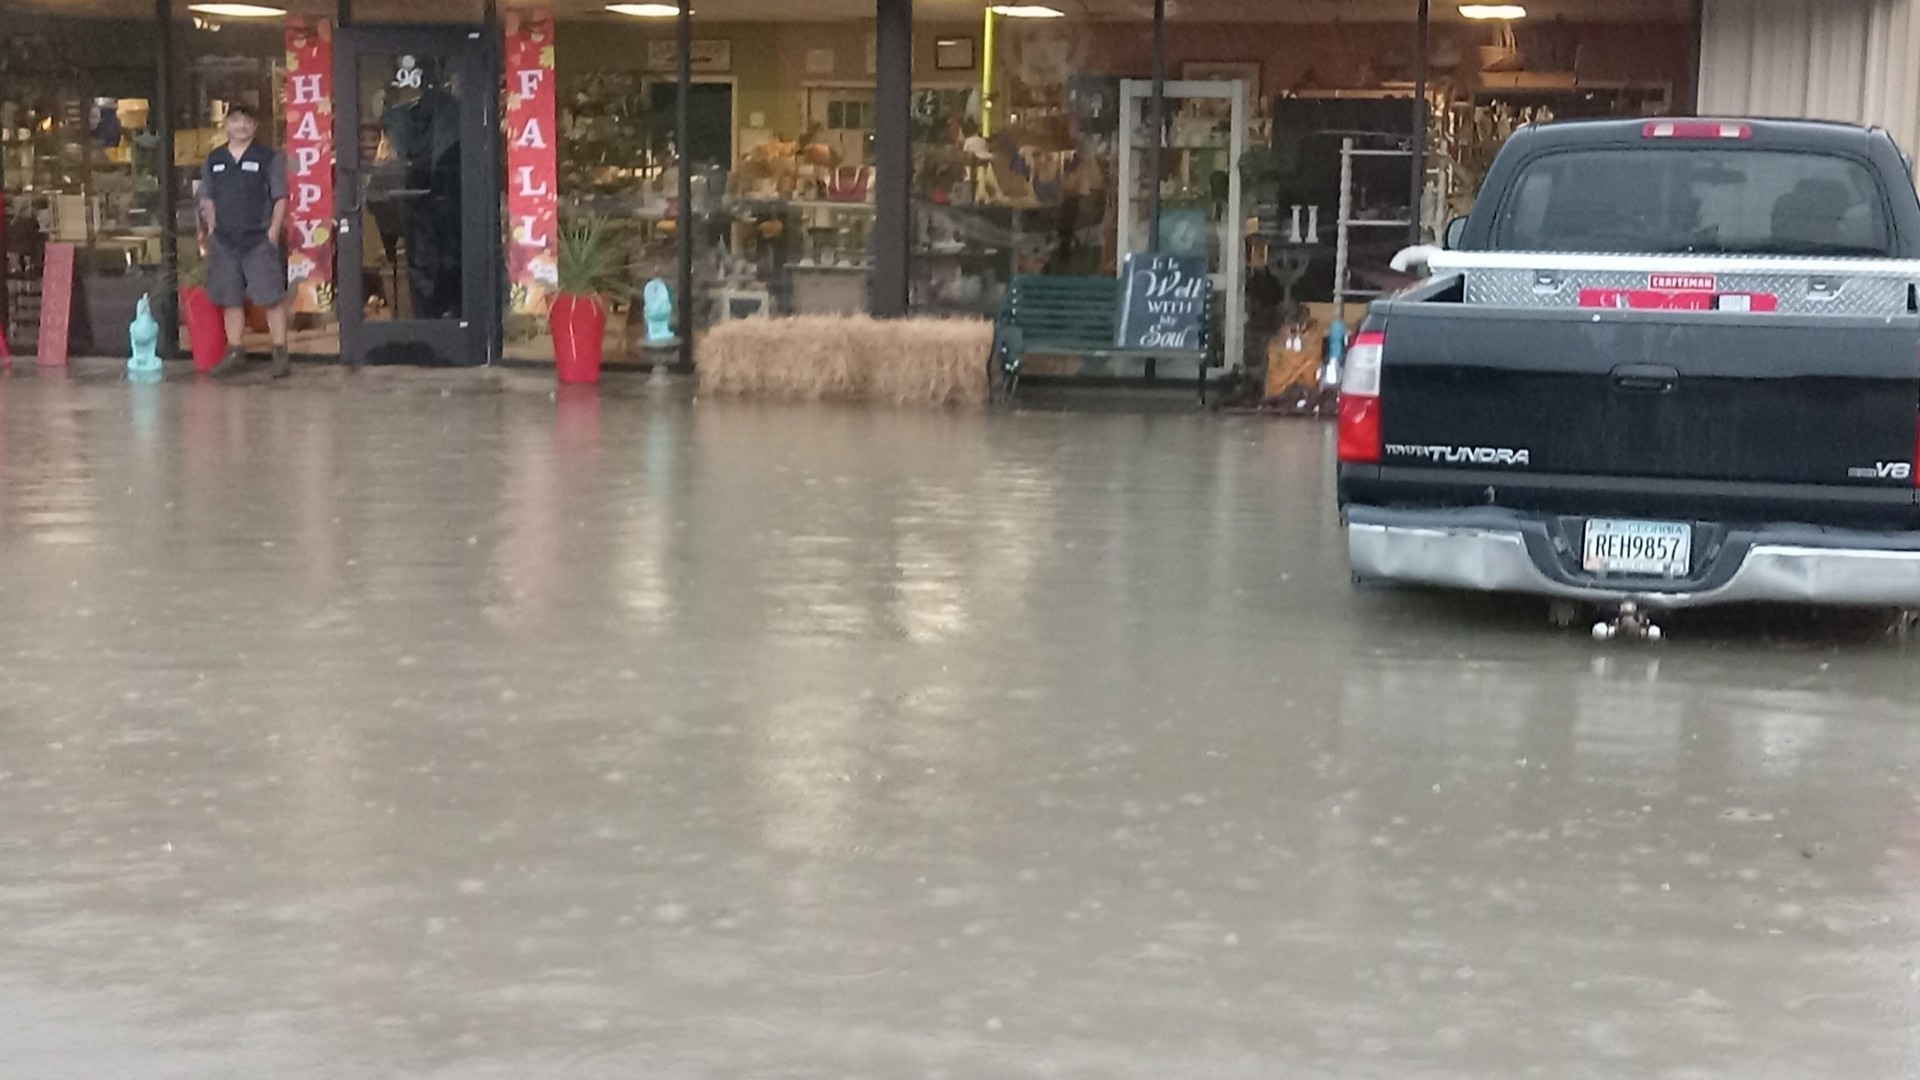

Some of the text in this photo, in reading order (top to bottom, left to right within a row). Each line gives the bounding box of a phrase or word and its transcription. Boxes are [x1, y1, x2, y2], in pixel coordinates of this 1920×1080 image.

[396, 68, 423, 89] 96
[292, 73, 327, 249] HAPPY
[517, 69, 547, 247] FALL
[1135, 270, 1202, 299] Well
[1652, 276, 1713, 289] CRAFTSMAN
[1147, 300, 1192, 314] WITH
[1139, 324, 1191, 348] Soul
[1429, 446, 1530, 466] TUNDRA
[1876, 461, 1911, 479] V8
[1628, 523, 1683, 536] GEORGIA
[1595, 534, 1681, 561] REH9857
